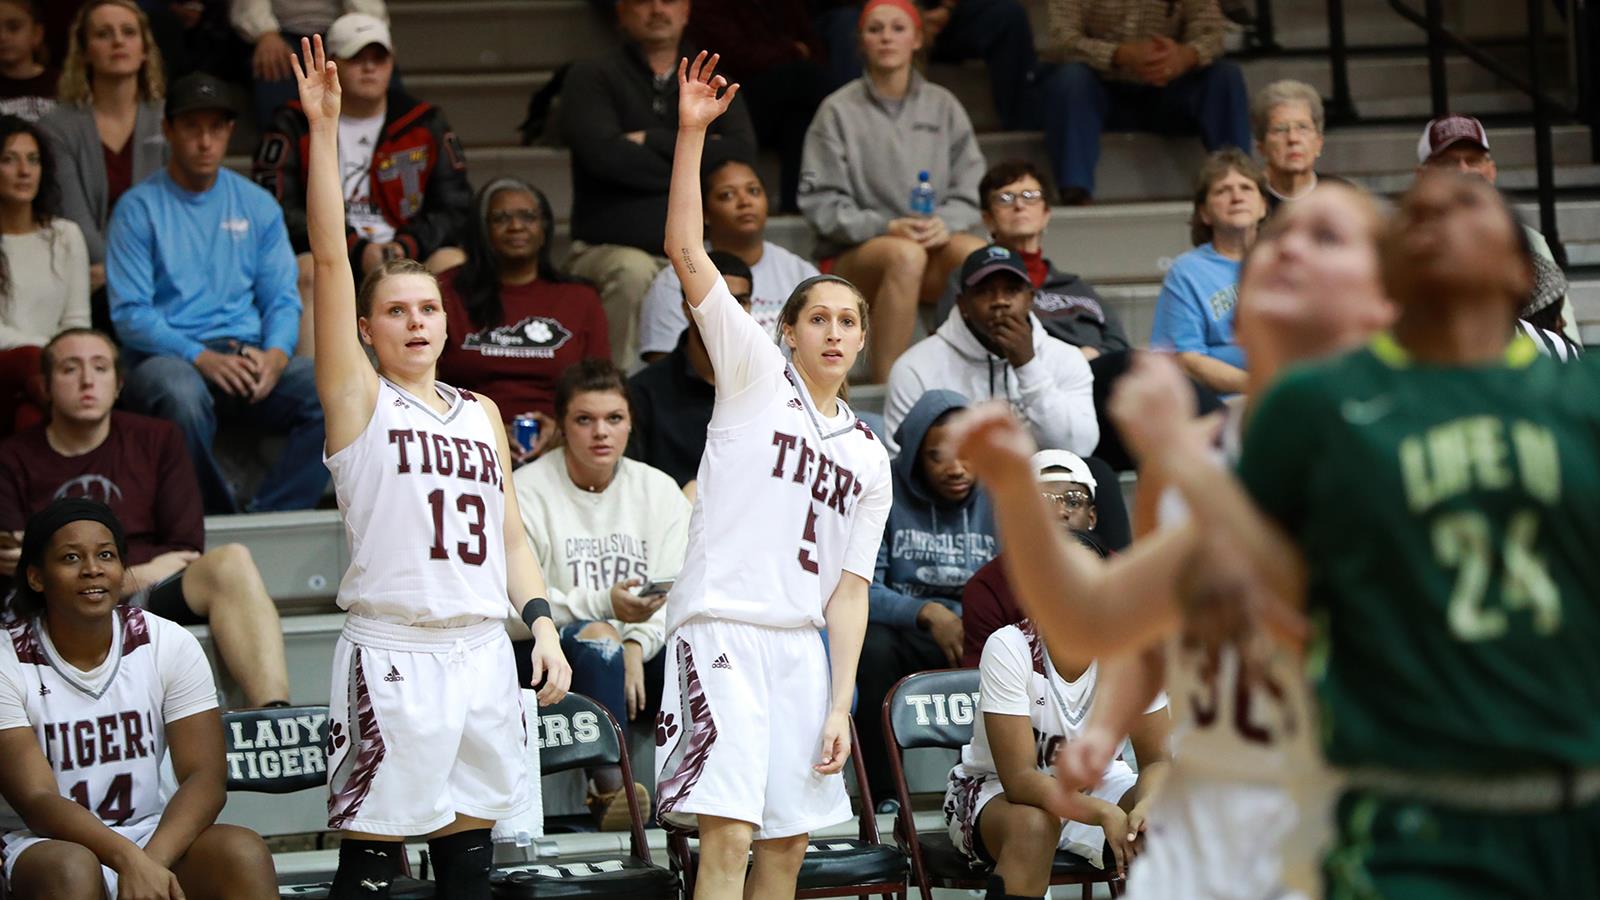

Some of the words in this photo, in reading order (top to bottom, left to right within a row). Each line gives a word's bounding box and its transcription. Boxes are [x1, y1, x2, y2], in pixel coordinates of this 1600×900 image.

[428, 488, 488, 567] 13
[567, 555, 648, 591] TGERS
[905, 692, 980, 726] TIG
[230, 713, 326, 749] LADY
[226, 745, 329, 780] TIGER
[69, 771, 135, 827] 14
